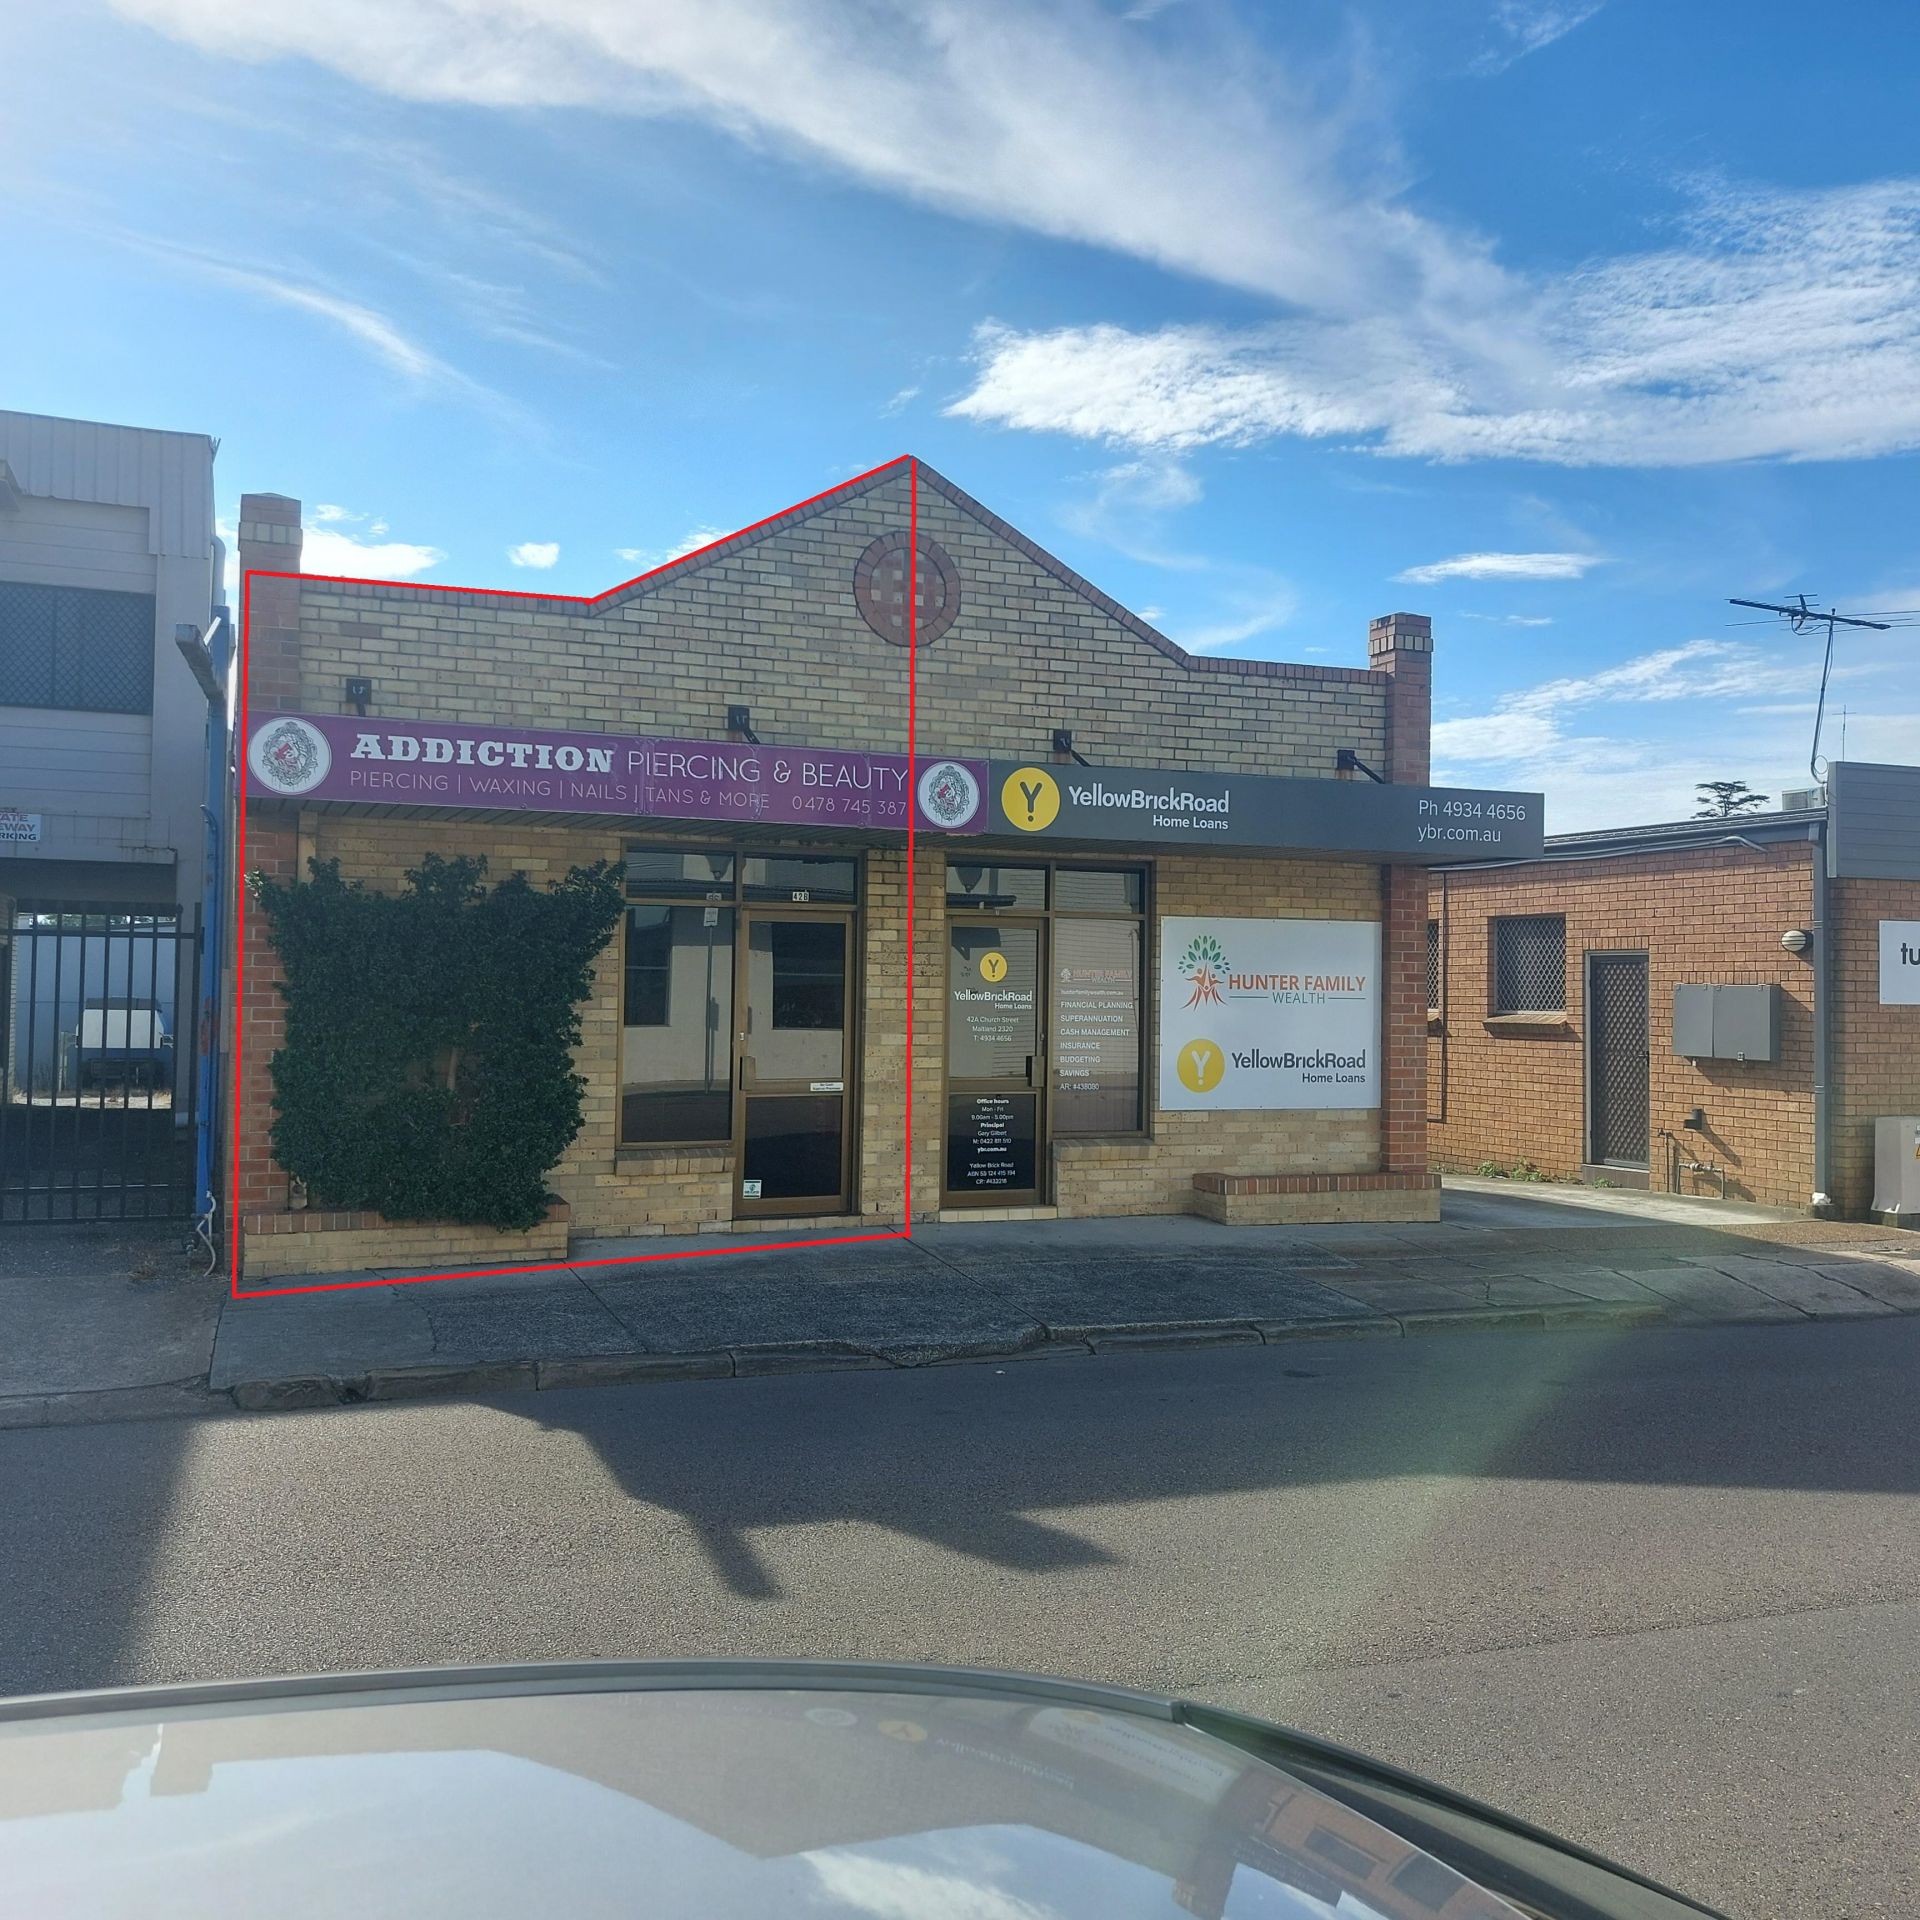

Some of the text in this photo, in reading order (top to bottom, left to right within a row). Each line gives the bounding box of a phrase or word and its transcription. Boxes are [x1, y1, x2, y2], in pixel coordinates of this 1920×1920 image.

[350, 733, 909, 791] ADDICTION PIERCING & BEAUTY
[350, 770, 907, 816] PIERCING WAXING NAILS TANS & MORE 0478 745 387
[1068, 785, 1230, 814] YellowBrickRoad
[1418, 797, 1526, 822] Ph 4934 4656
[1152, 814, 1229, 831] Home Loans
[1417, 823, 1501, 844] ybr.com.au
[1228, 974, 1367, 992] HUNTER FAMILY
[954, 989, 1033, 1002] YellowBrickRoad
[1272, 992, 1326, 1004] WEALTH
[994, 1002, 1032, 1010] Home Loans
[1060, 1001, 1134, 1010] FINANCIAL PLANNING
[1060, 1015, 1124, 1023] SUPERANNUATION
[1060, 1028, 1131, 1037] CASH MANAGEMENT
[1060, 1042, 1101, 1050] INSURANCE
[1059, 1055, 1101, 1063] BUDGETING
[1231, 1048, 1366, 1070] YellowBrickRoad
[1059, 1069, 1090, 1077] SAVINGS
[1301, 1072, 1366, 1084] Home Loans
